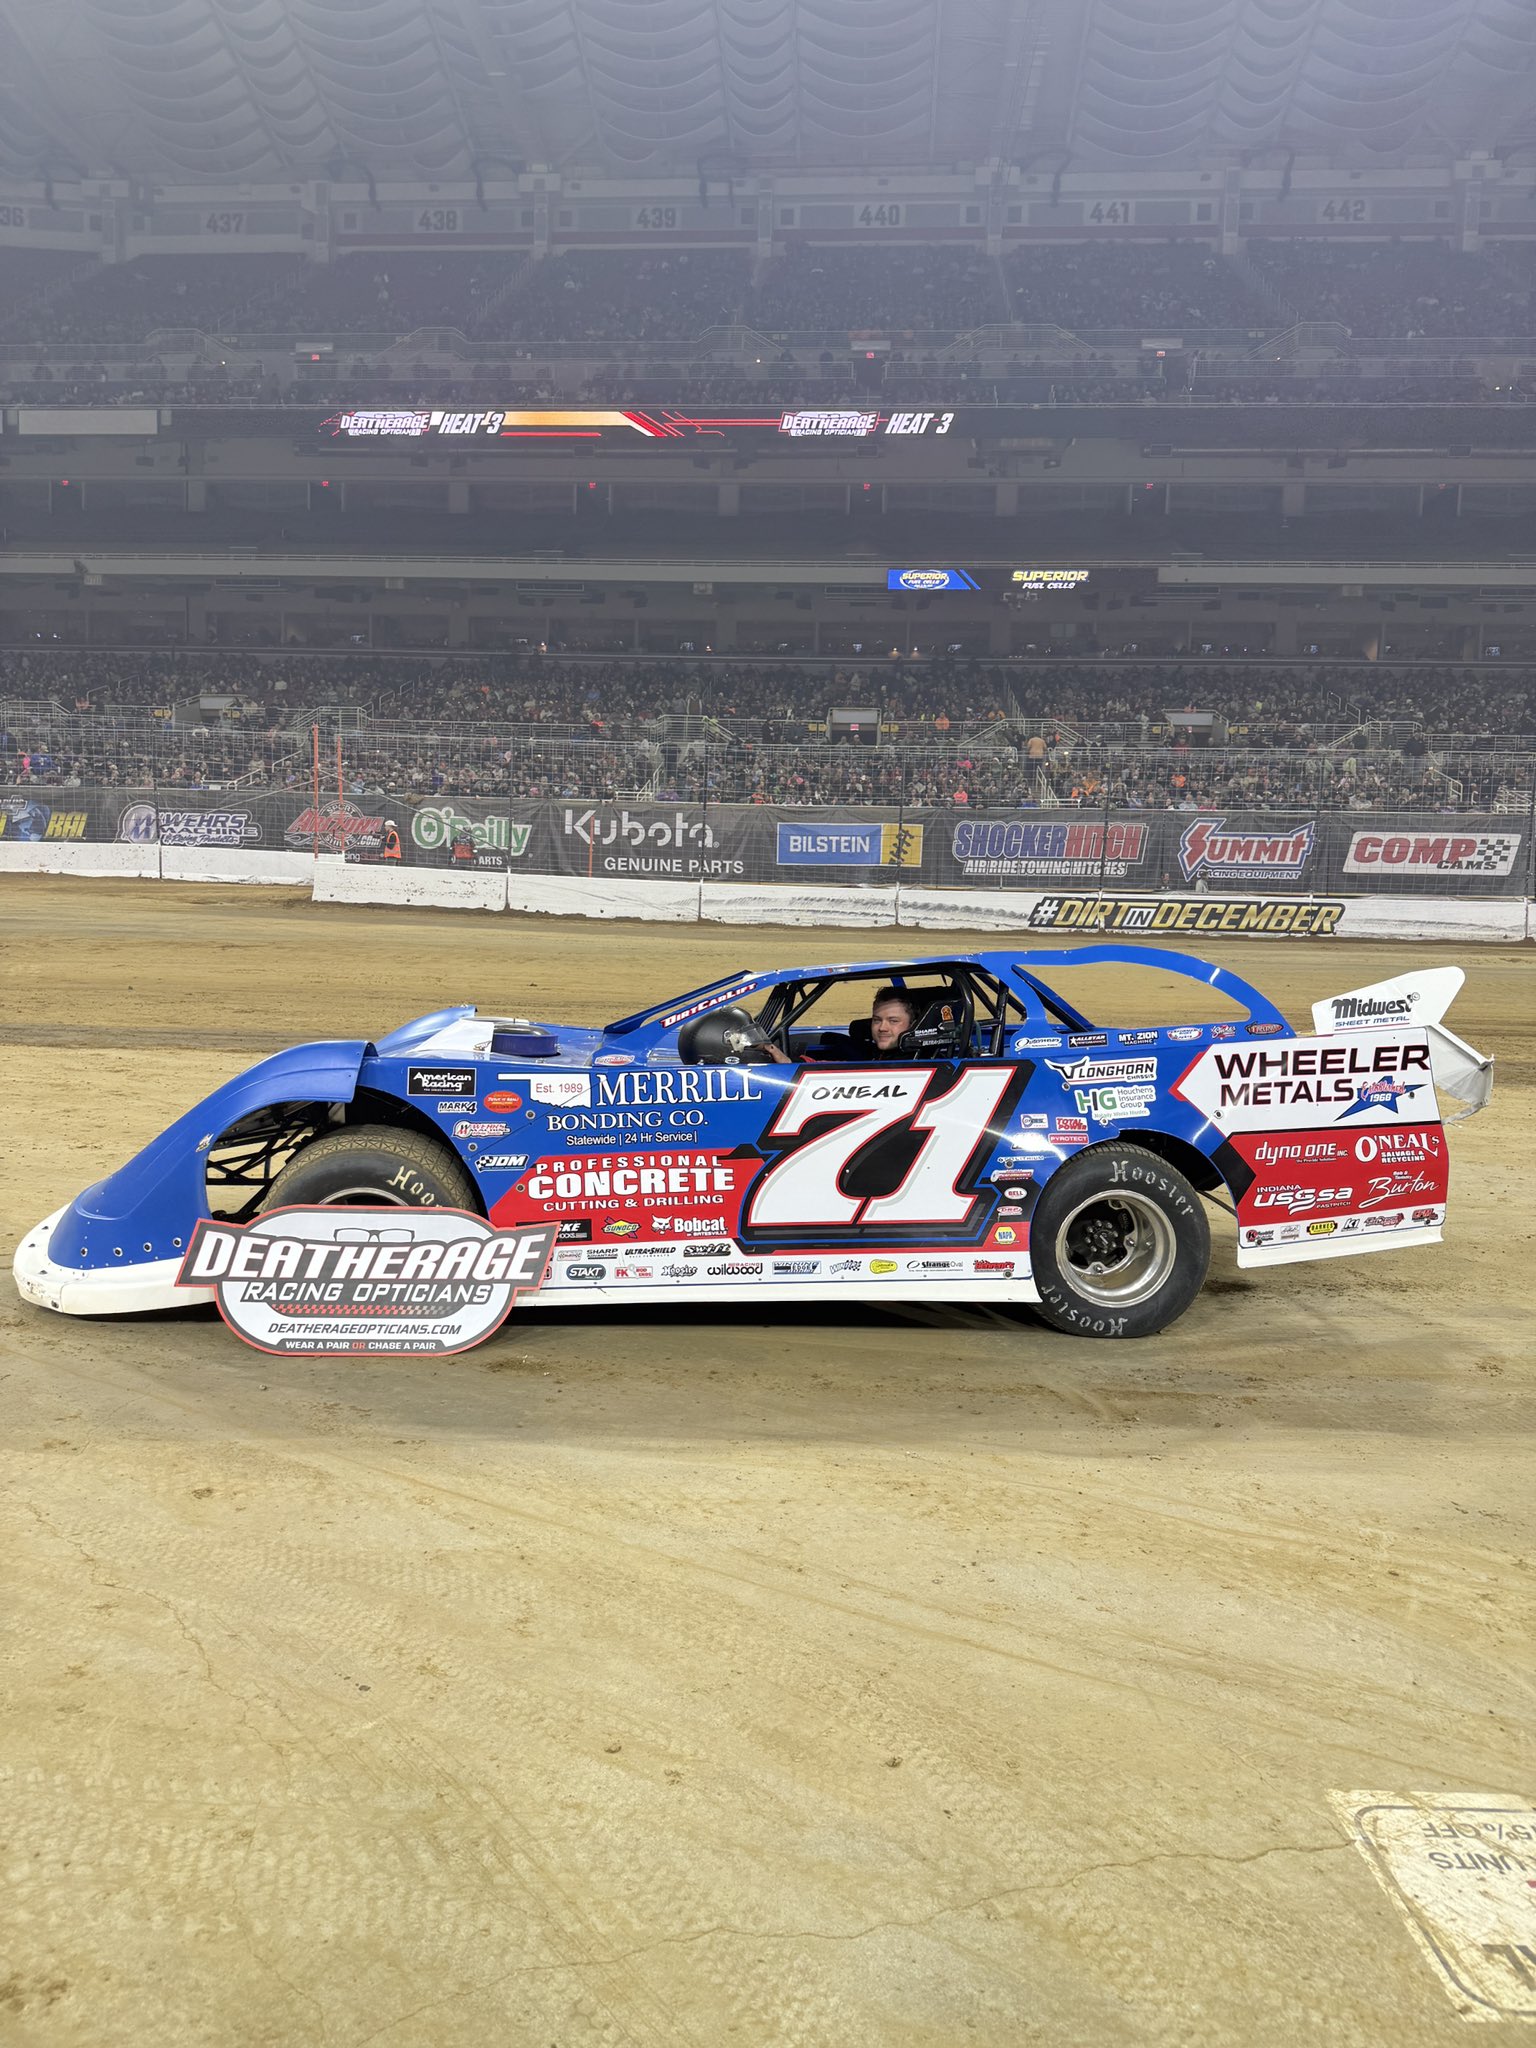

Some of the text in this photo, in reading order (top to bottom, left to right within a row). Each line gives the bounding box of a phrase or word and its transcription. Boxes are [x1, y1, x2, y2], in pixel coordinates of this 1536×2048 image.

[636, 207, 677, 229] 439
[858, 204, 900, 227] 440
[1089, 202, 1130, 224] 441
[1322, 200, 1366, 221] 442
[205, 212, 244, 234] 437
[418, 210, 458, 231] 438
[340, 414, 430, 429] DEATHERAGE
[438, 413, 504, 434] HEAT 3
[781, 413, 878, 430] DEATHERAGE
[884, 413, 954, 434] HEAT 3
[902, 572, 948, 581] SUPERIOR
[1012, 570, 1089, 582] SUPERIOR
[1022, 582, 1045, 590] FUEL
[326, 802, 356, 815] SPORT
[163, 812, 248, 828] WEHRS
[564, 808, 714, 848] Kubota
[161, 827, 258, 836] MACHINE
[789, 835, 870, 854] BILSTEIN
[1353, 837, 1477, 865] COMP
[604, 857, 744, 874] GENUINE PARTS
[964, 860, 987, 874] AIR
[988, 860, 1018, 875] RIDE
[1020, 861, 1070, 875] TOWING
[1437, 859, 1497, 870] CAMS
[1238, 870, 1301, 879] EQUIPMENT
[1331, 994, 1413, 1019] Midwest
[1335, 1015, 1410, 1027] SHEET METAL
[1136, 1031, 1158, 1040] ZION
[1213, 1044, 1430, 1080] WHEELER
[413, 1071, 472, 1082] American
[1078, 1063, 1155, 1078] LONGHORN
[421, 1080, 464, 1092] Racing
[535, 1082, 583, 1093] Est. 1989
[596, 1068, 763, 1107] MERRILL
[811, 1084, 908, 1100] O'NEAL
[1117, 1087, 1153, 1095] Houchens
[1220, 1079, 1354, 1107] METALS
[1118, 1094, 1154, 1102] Insurance
[1120, 1101, 1143, 1109] Group
[1369, 1093, 1392, 1102] 1968
[547, 1109, 709, 1132] BONDING CO.
[566, 1131, 693, 1146] Statewide 24 Hr Service
[747, 1066, 1019, 1227] 71
[1255, 1141, 1302, 1166] dyno
[1381, 1156, 1426, 1164] RECYCLING
[535, 1155, 723, 1175] PROFESSIONAL
[527, 1168, 736, 1200] CONCRETE
[1256, 1184, 1302, 1193] INDIANA
[1360, 1171, 1440, 1206] Burton
[542, 1194, 725, 1212] CUTTING & DRILLING
[605, 1224, 638, 1232] SUNOCO
[673, 1216, 727, 1233] Bobcat
[998, 1231, 1013, 1240] NAPA
[190, 1230, 547, 1281] DEATHERAGE
[569, 1267, 603, 1277] STAKT
[616, 1269, 629, 1277] FK
[707, 1262, 763, 1276] wilwood
[243, 1282, 493, 1304] RACING OPTICIANS
[267, 1323, 463, 1335] DEATHERAGEOPTICIANS.COM
[285, 1341, 436, 1350] WEAR A PAIR OR CHASE A PAIR
[1428, 1852, 1528, 1873] UNITS
